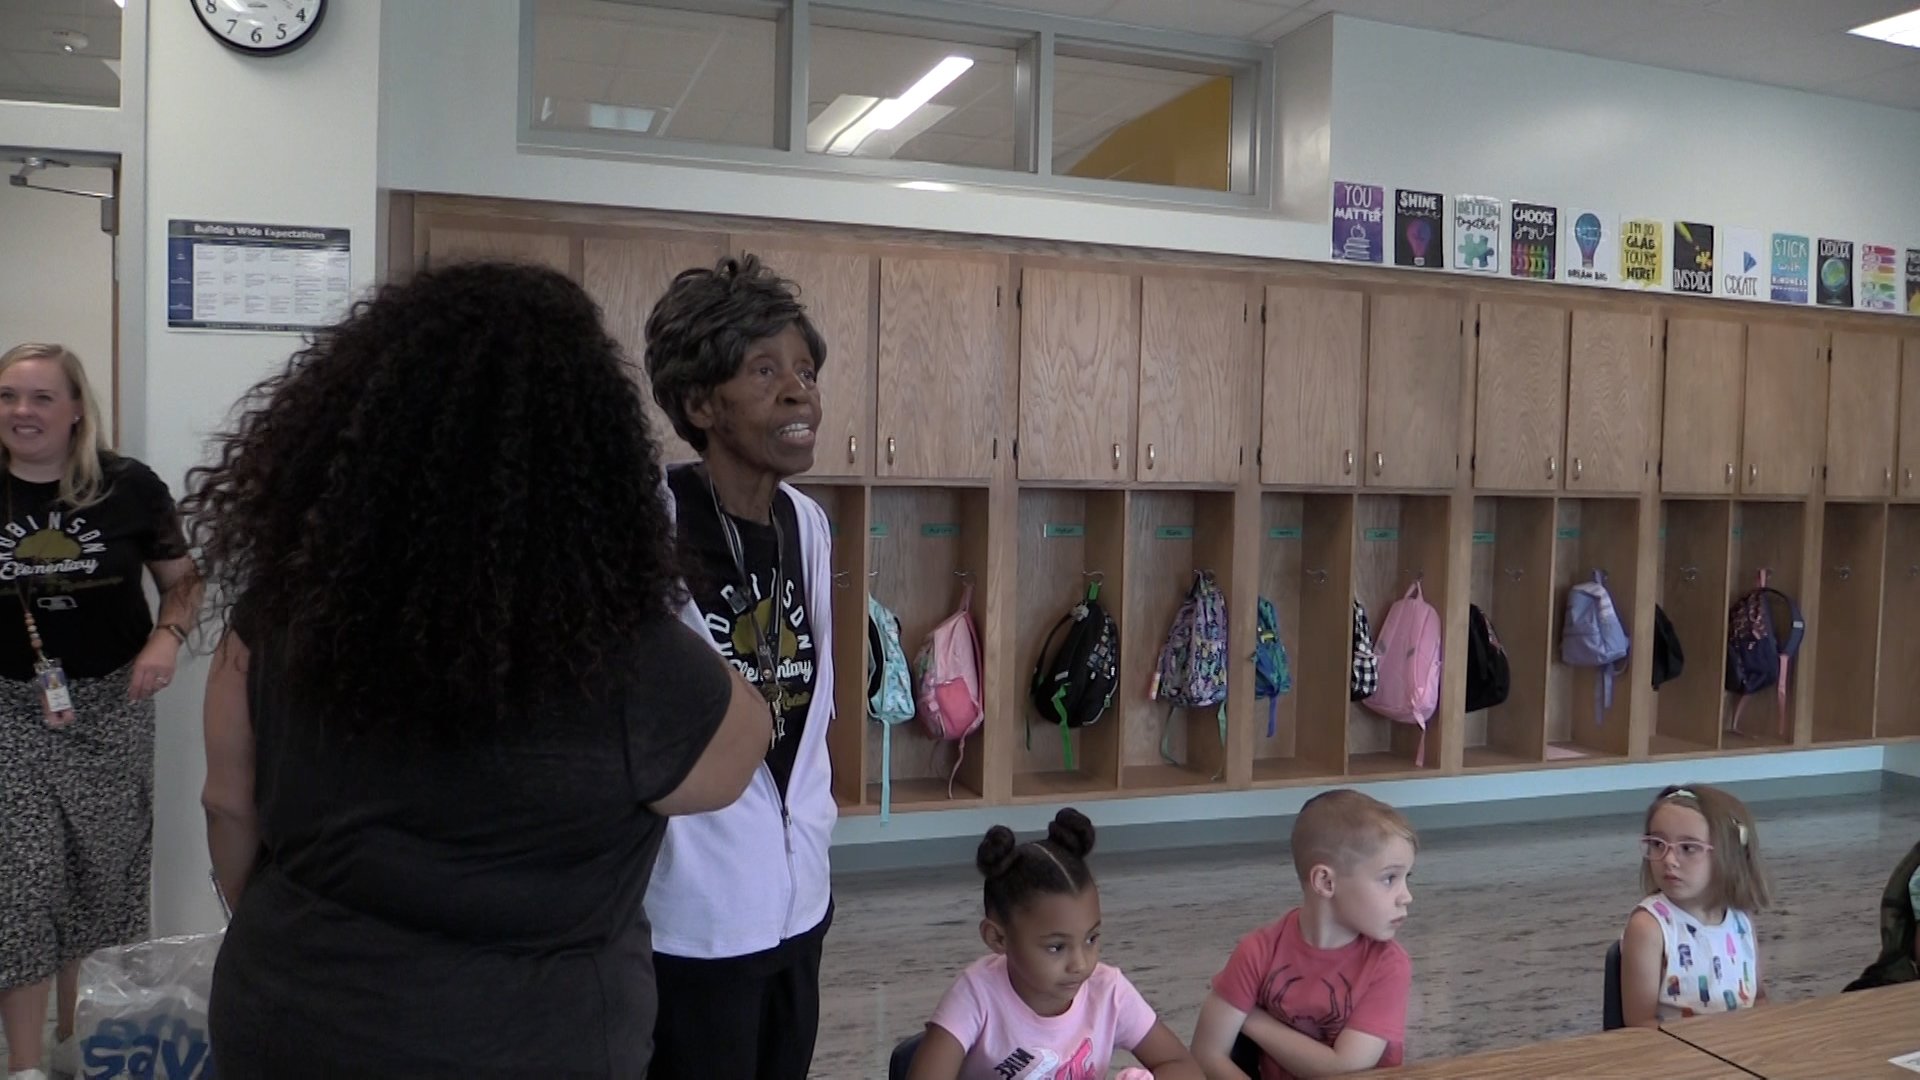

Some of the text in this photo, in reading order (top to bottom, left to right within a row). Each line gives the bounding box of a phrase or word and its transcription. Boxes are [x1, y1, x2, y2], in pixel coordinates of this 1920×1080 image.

[205, 0, 217, 14] 8
[295, 7, 306, 22] 4
[226, 19, 238, 35] 7
[250, 27, 263, 43] 6
[275, 23, 287, 40] 5
[1344, 185, 1372, 208] YOU
[1400, 191, 1437, 210] SHINE
[1334, 207, 1382, 222] MATTER
[1513, 207, 1554, 226] CHOOSE
[194, 224, 325, 240] Building Wide Expectations
[1774, 239, 1807, 258] STICK
[1777, 261, 1801, 272] with
[0, 558, 99, 580] Elementary
[993, 1047, 1035, 1080] NIKE
